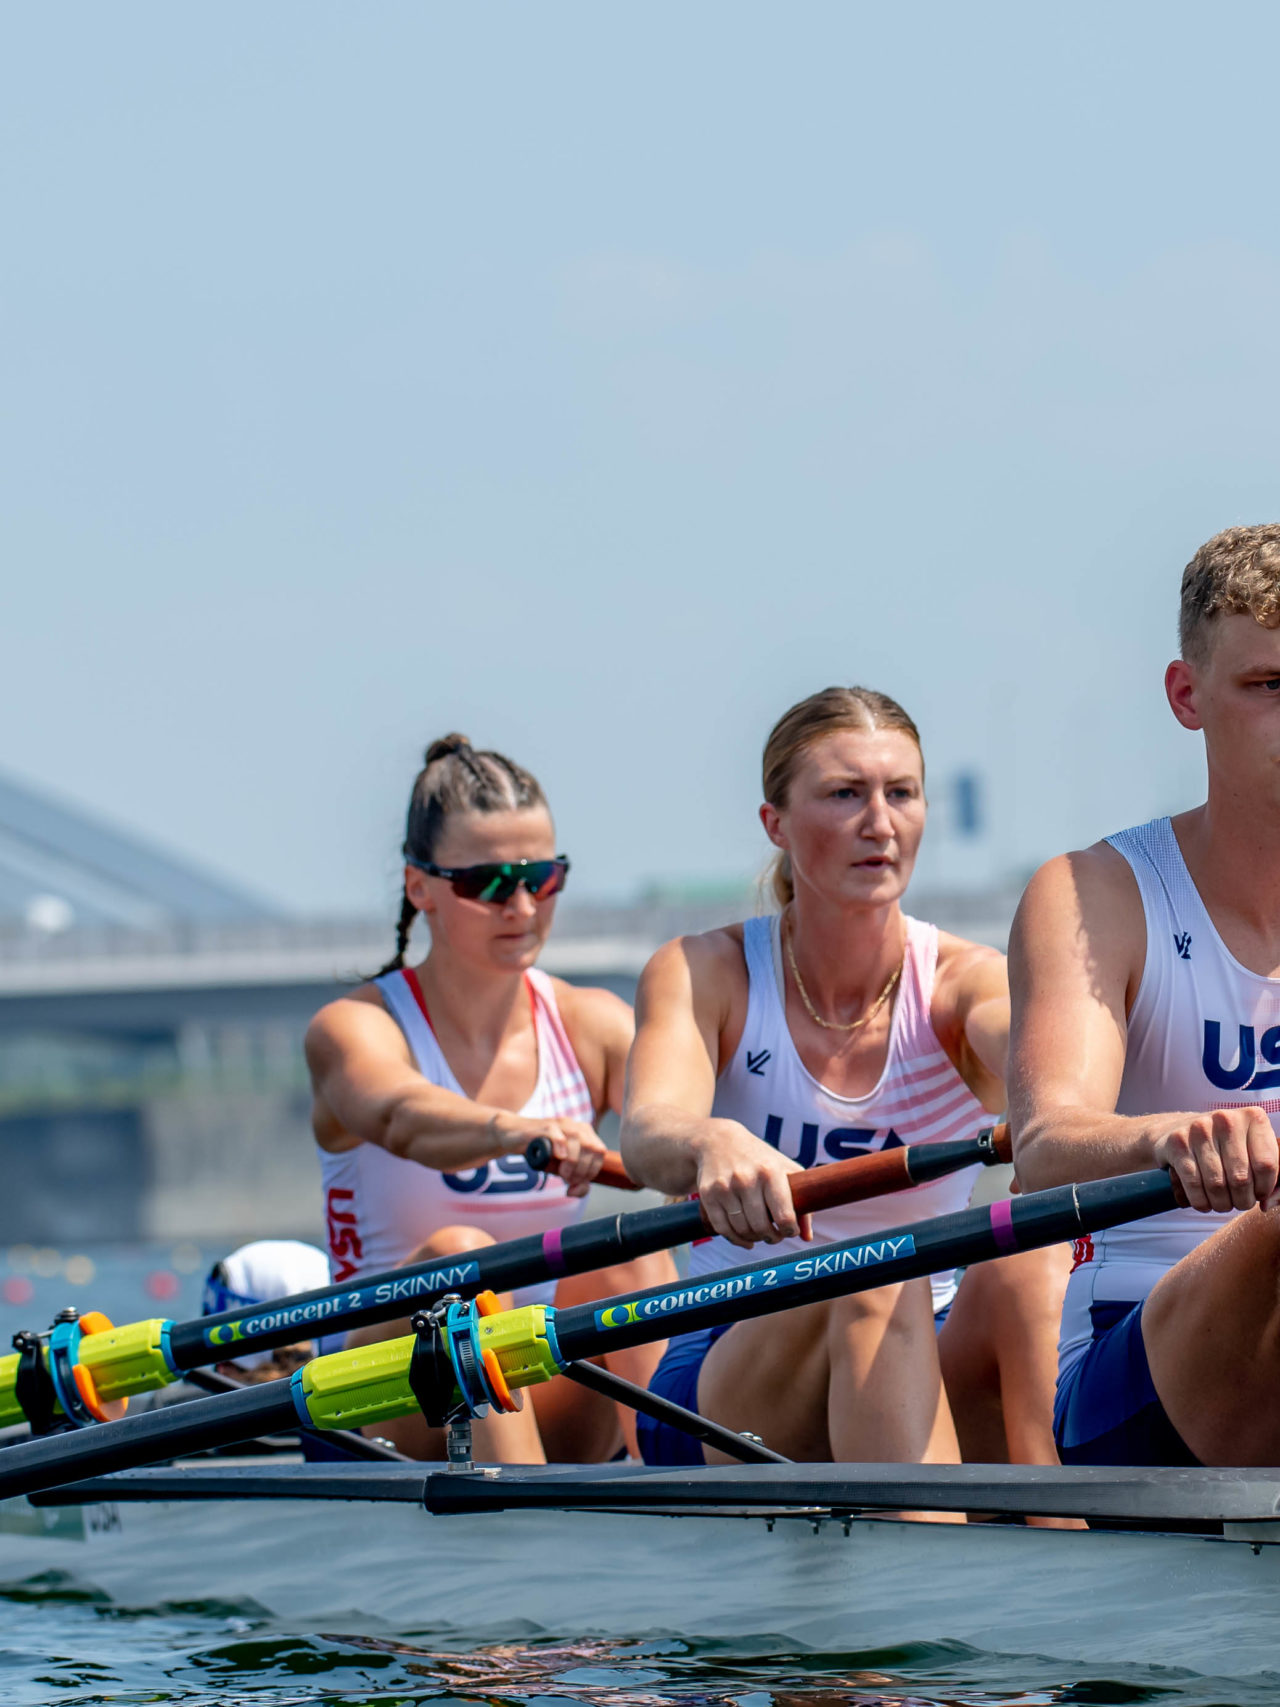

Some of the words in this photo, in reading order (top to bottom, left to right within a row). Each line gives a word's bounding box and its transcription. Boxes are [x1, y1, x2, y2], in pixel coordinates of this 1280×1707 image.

[764, 1113, 907, 1170] US
[328, 1188, 363, 1283] USA
[246, 1297, 342, 1334] concept
[347, 1292, 362, 1308] 2
[375, 1264, 473, 1304] SKINNY
[644, 1274, 755, 1316] concept
[762, 1270, 778, 1287] 2
[793, 1237, 907, 1281] SKINNY
